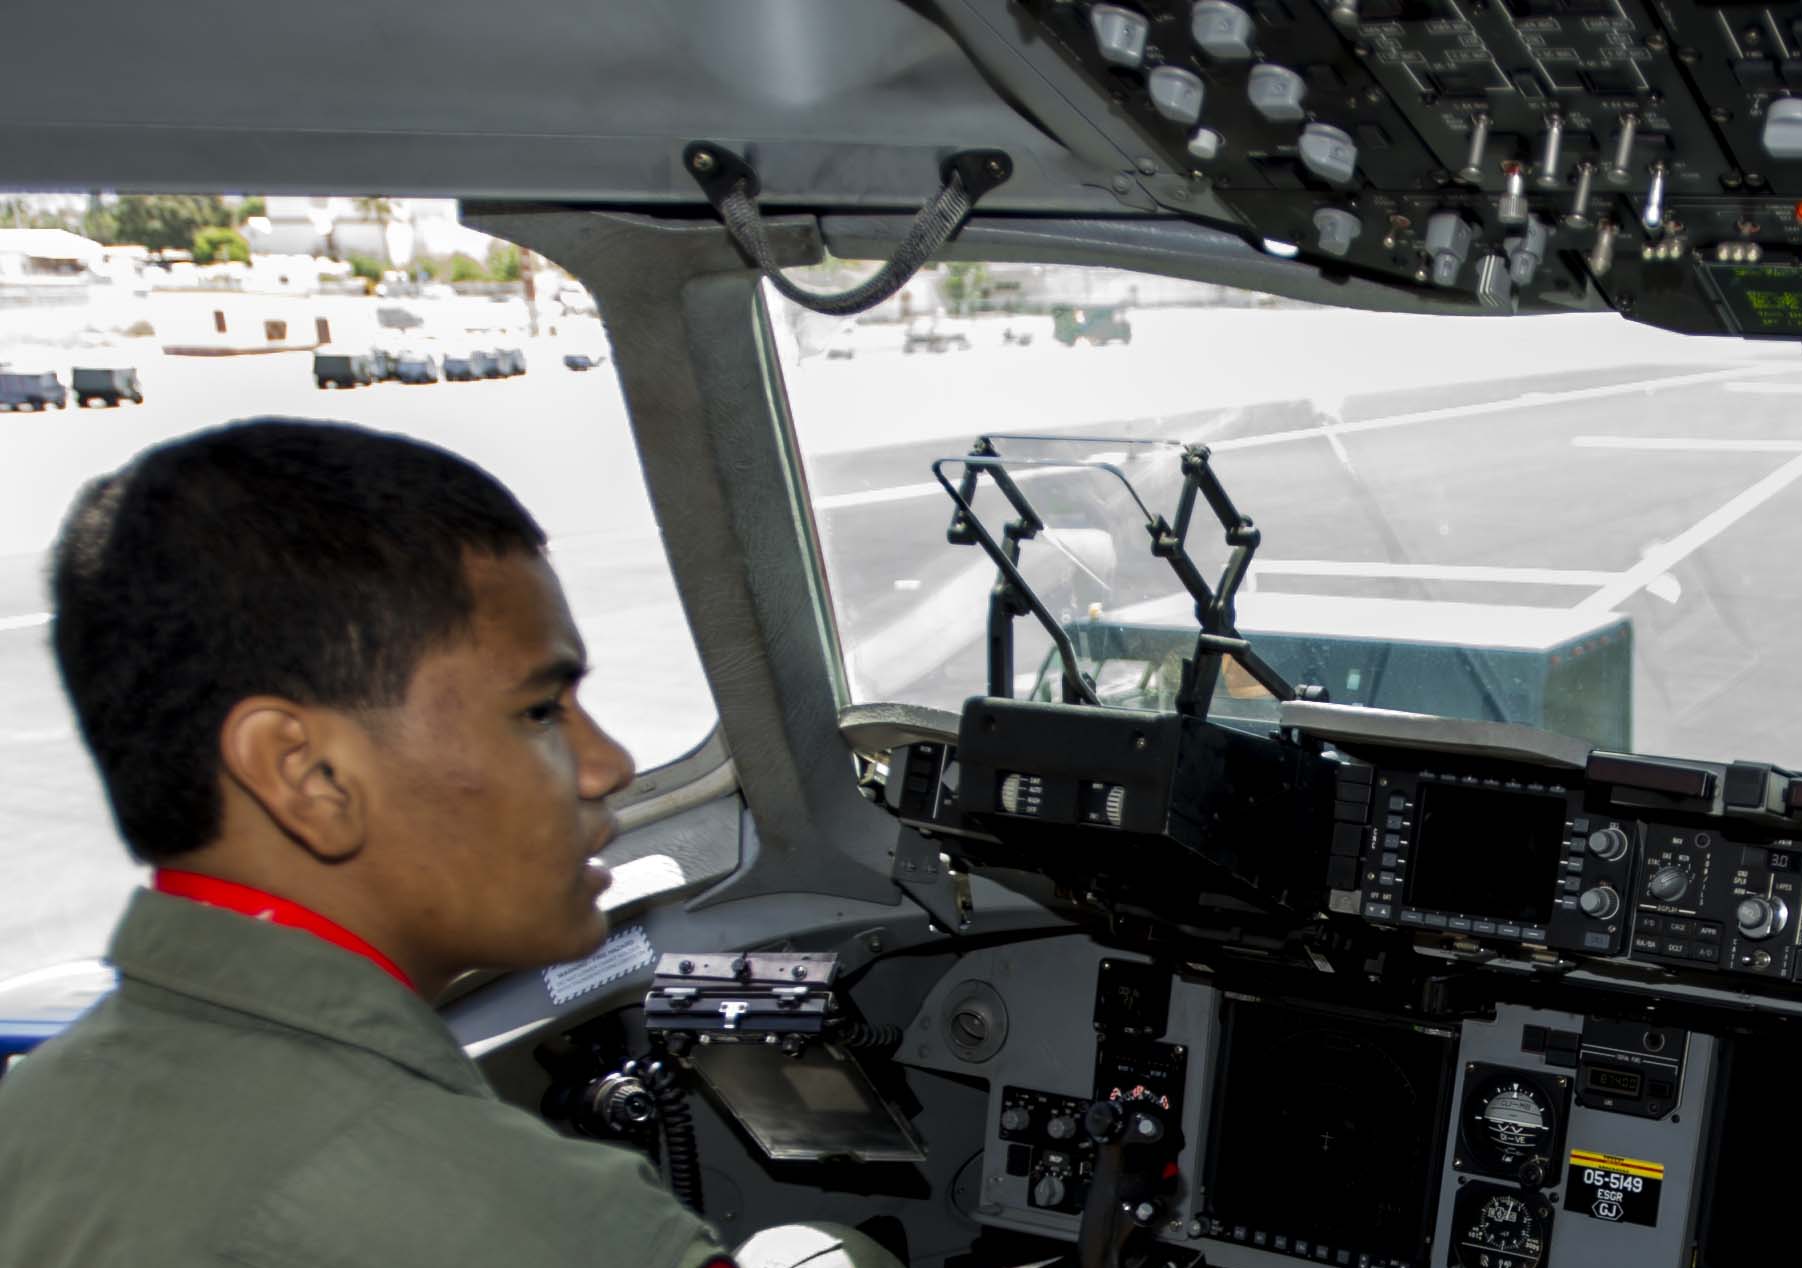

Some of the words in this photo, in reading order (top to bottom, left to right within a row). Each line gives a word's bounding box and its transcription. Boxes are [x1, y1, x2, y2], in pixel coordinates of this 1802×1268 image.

[1583, 1168, 1644, 1194] 05-5149
[1597, 1189, 1624, 1203] ESGR
[1599, 1203, 1617, 1217] GJ
